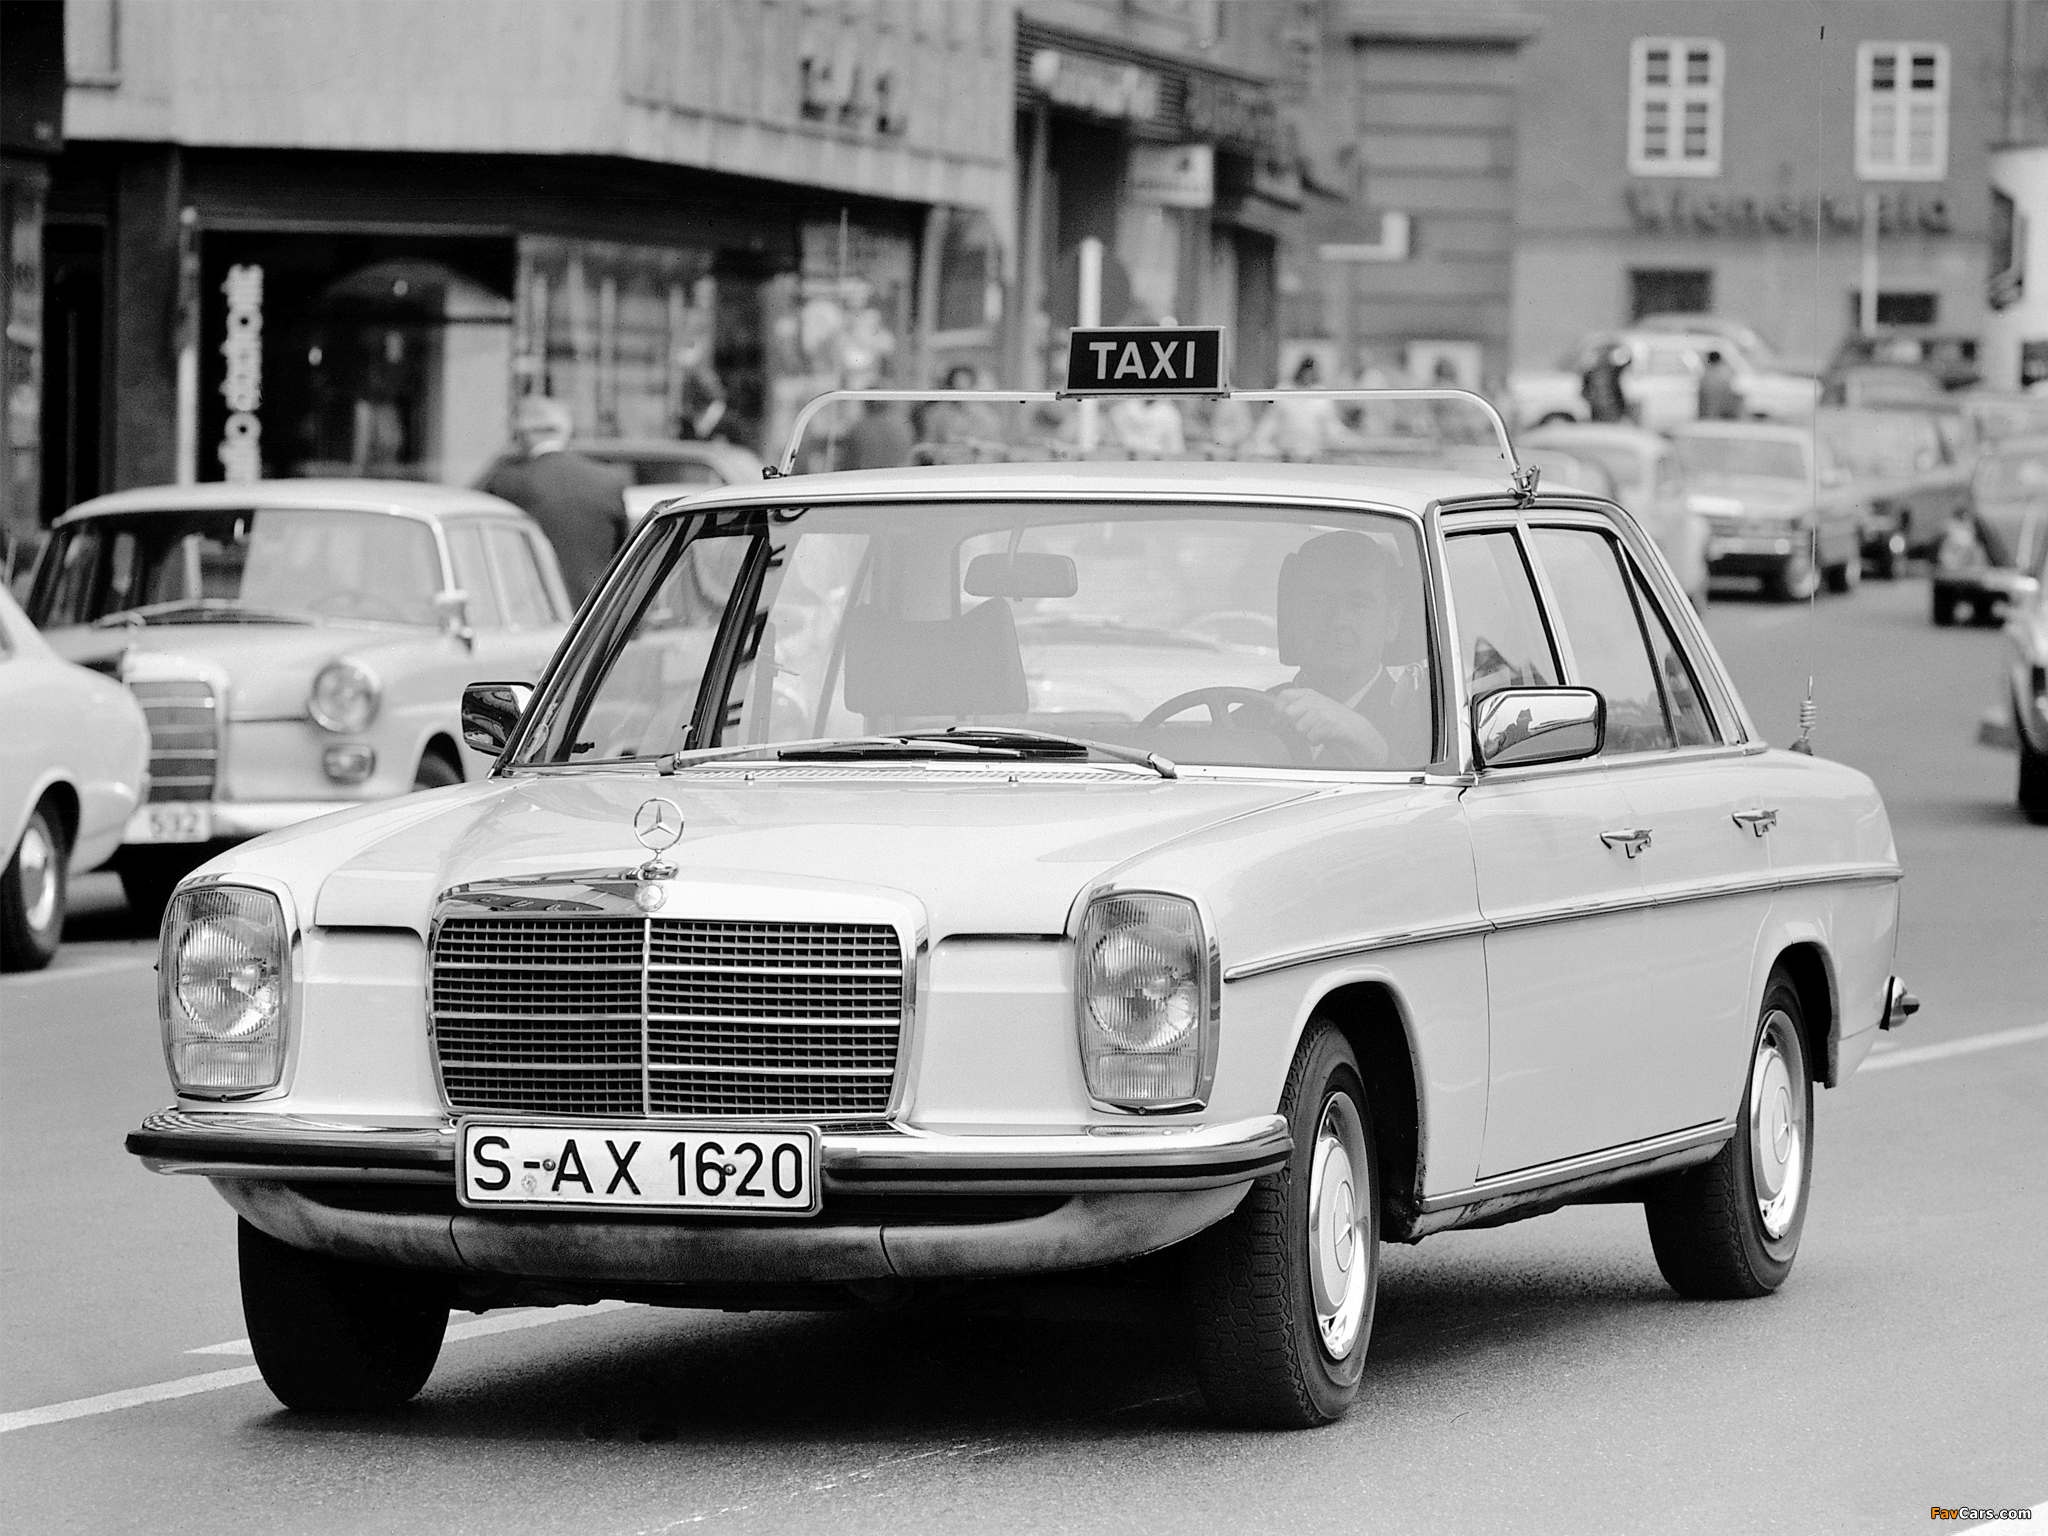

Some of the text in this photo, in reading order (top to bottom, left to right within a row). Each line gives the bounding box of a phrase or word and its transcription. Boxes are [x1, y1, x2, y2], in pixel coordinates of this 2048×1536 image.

[1089, 341, 1196, 380] TAXI
[473, 1135, 804, 1200] S-AX 1620
